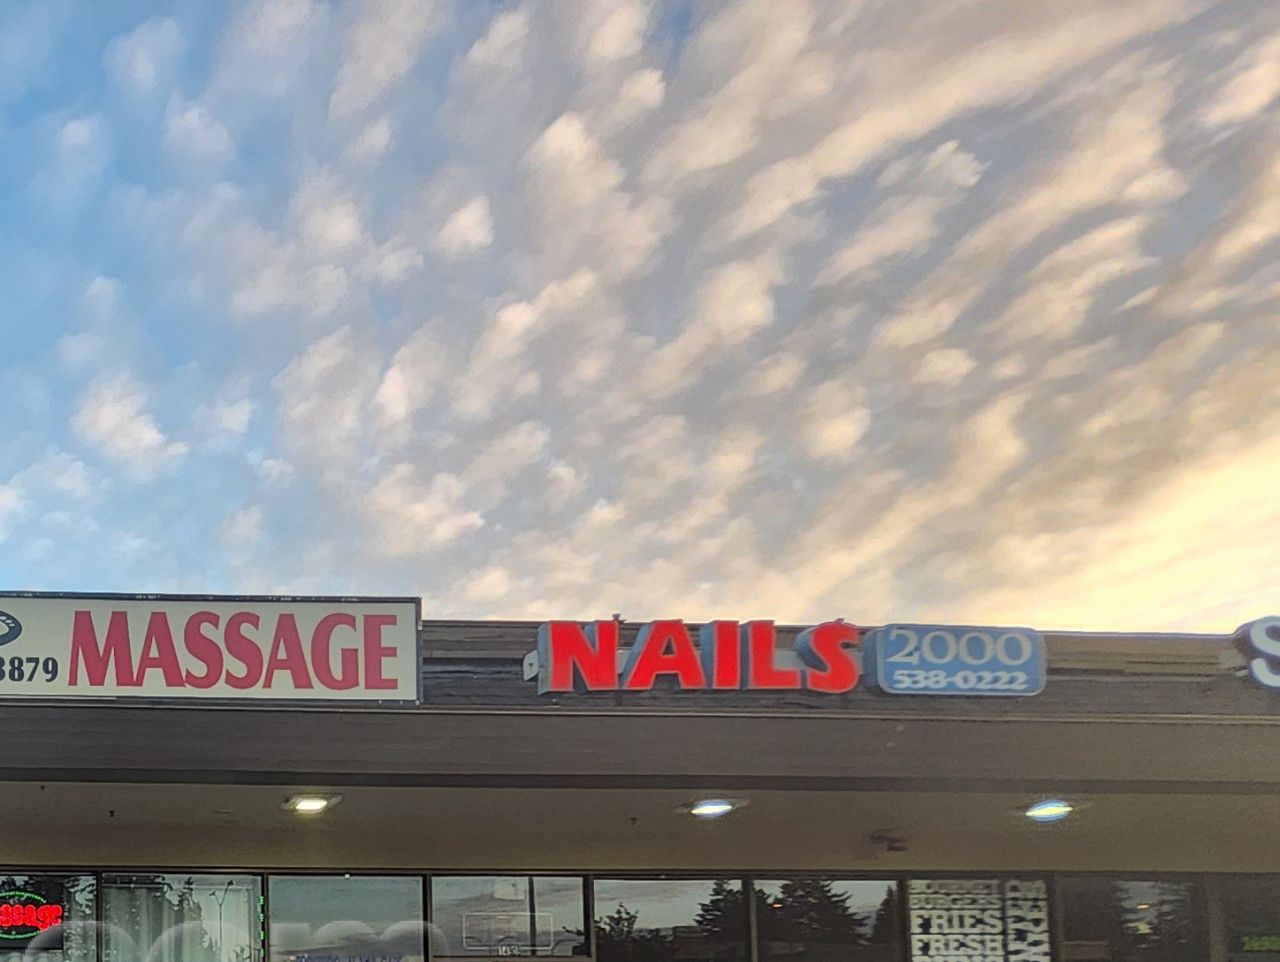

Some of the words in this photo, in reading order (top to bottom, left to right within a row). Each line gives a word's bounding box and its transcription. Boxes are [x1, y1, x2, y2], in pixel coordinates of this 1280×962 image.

[68, 610, 398, 690] MASSAGE
[546, 620, 860, 693] NAILS
[887, 630, 1030, 665] 2000
[893, 671, 1028, 690] 538-0222
[910, 910, 1004, 934] FRIES
[911, 935, 1005, 955] FRESH
